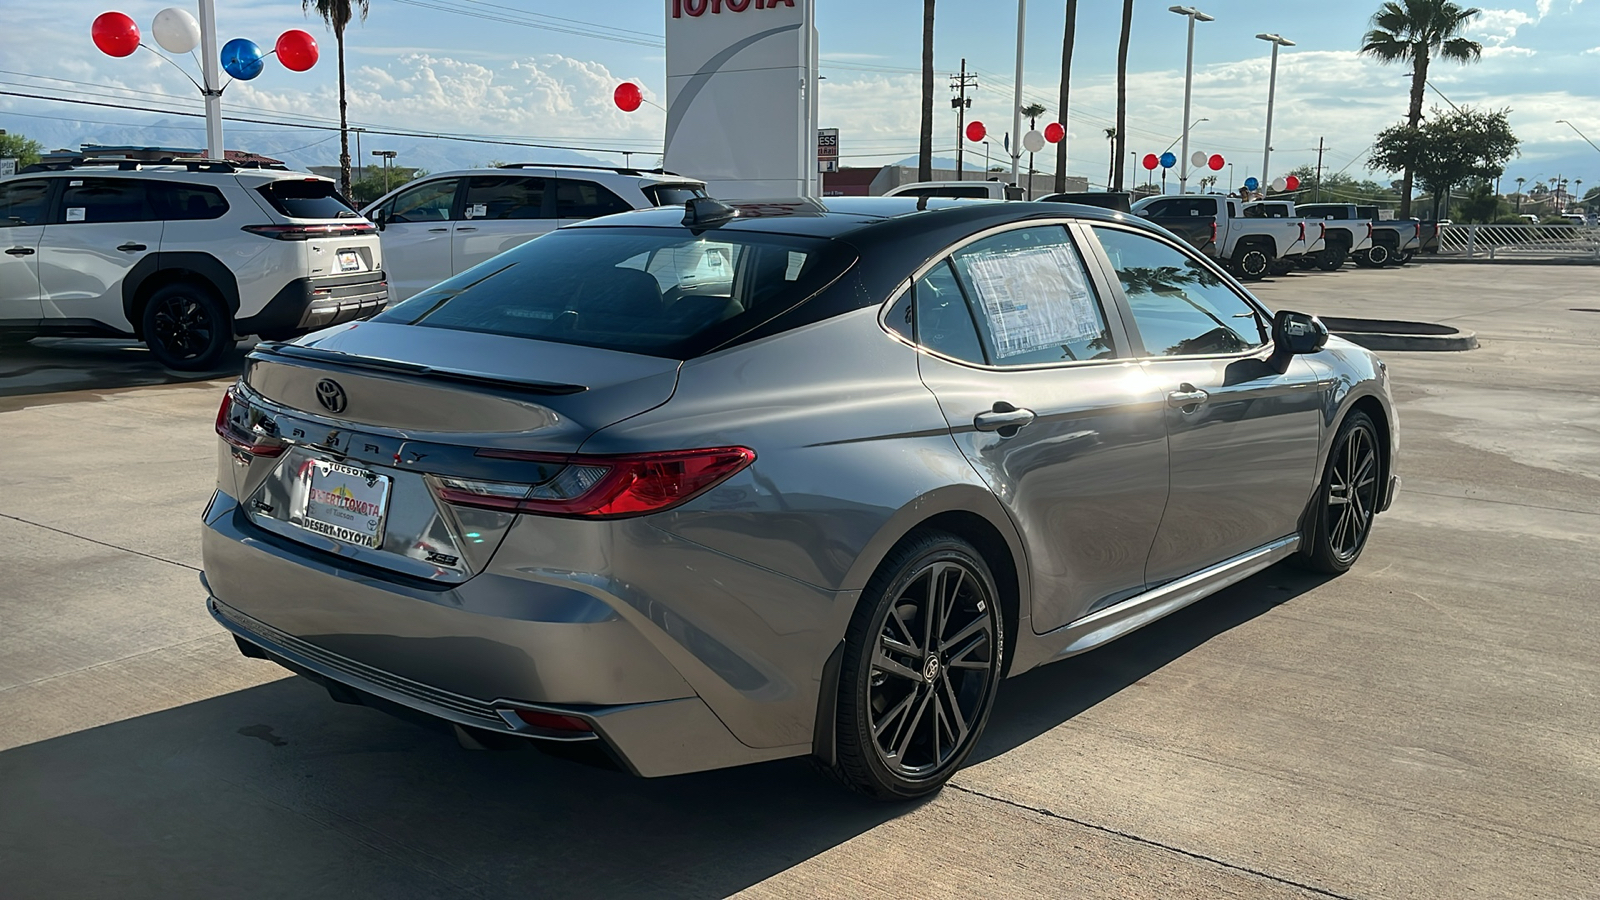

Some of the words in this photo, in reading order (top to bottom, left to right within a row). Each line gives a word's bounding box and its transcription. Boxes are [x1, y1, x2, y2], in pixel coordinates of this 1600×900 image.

[818, 136, 836, 146] ESS
[329, 463, 366, 477] TUCSON
[344, 497, 379, 517] TOYOTA
[333, 508, 354, 521] Tucson
[304, 519, 335, 535] DESERT
[336, 527, 373, 547] TOYOTA
